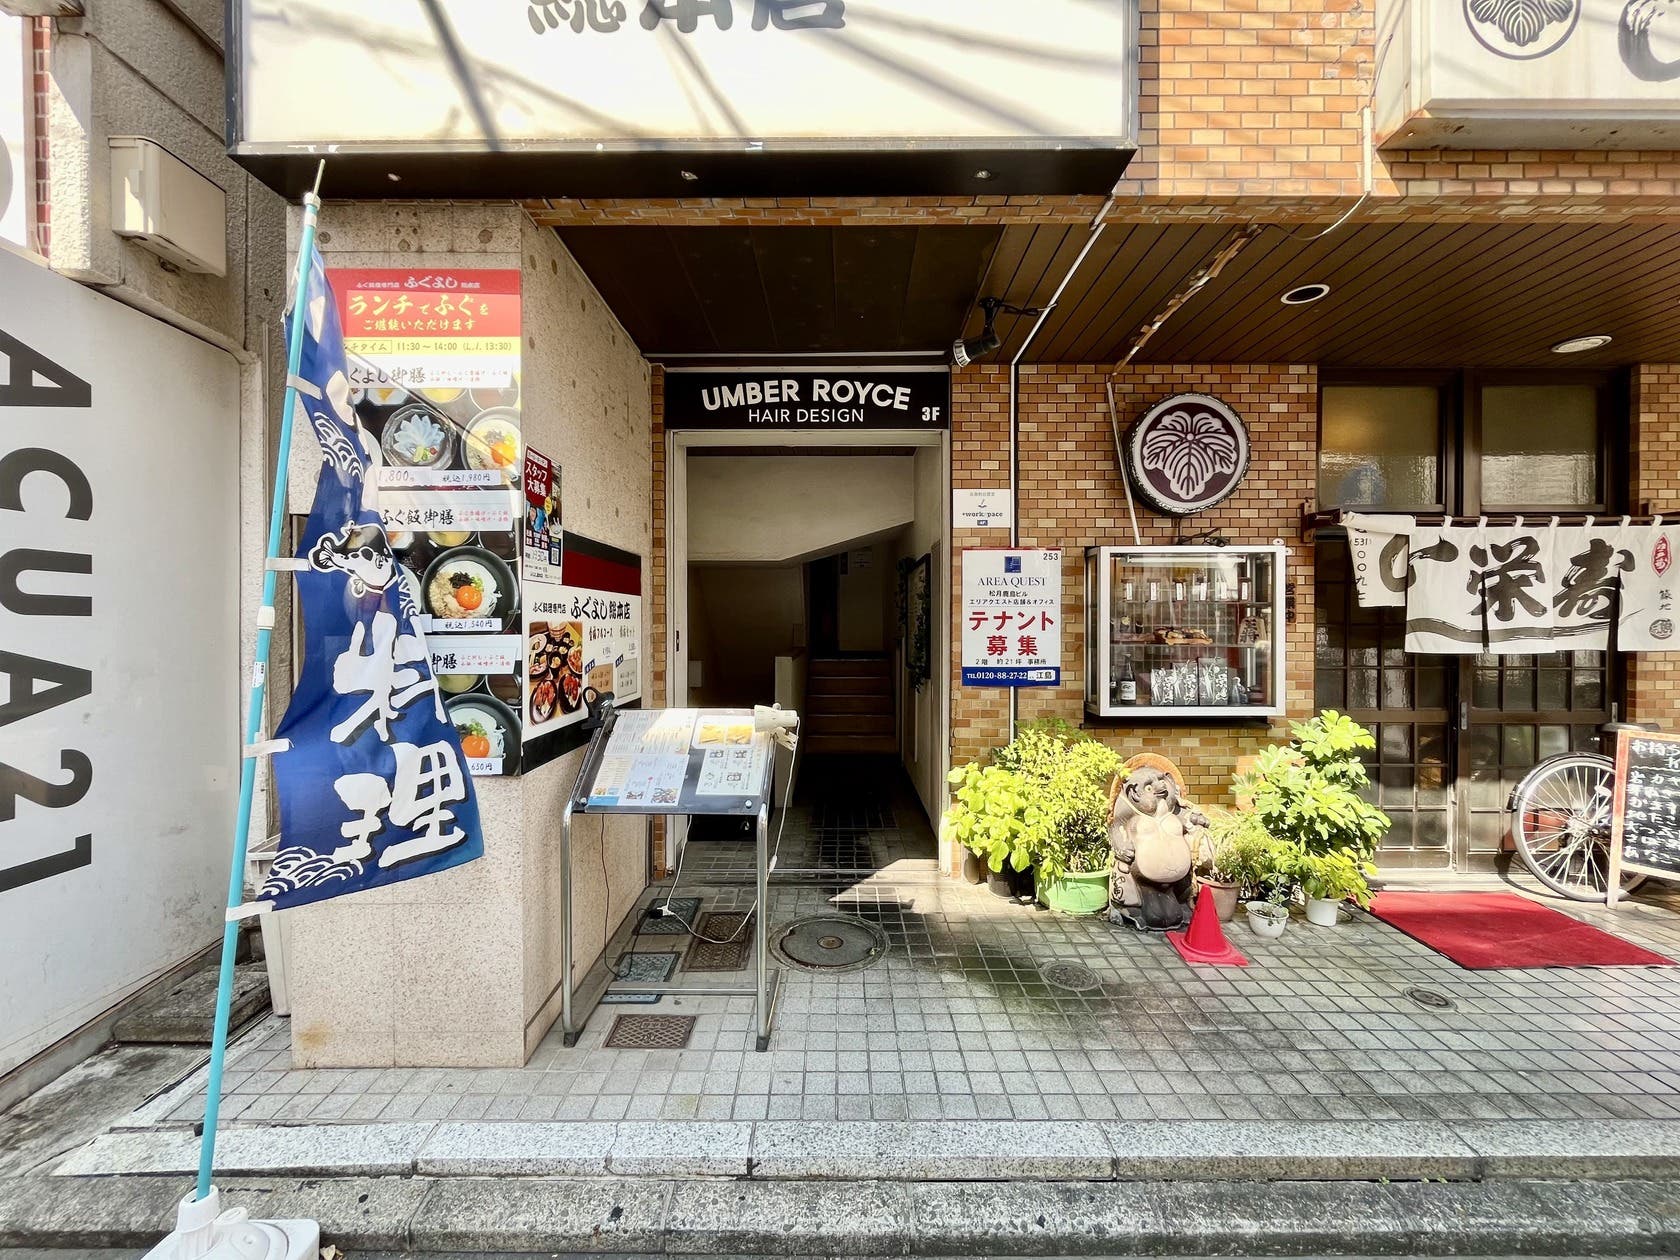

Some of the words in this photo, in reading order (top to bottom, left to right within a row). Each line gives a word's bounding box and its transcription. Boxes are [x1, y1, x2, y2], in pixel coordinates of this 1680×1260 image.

[404, 276, 457, 288] ふぐよし
[363, 319, 476, 331] ご堪能いただけます
[701, 379, 800, 410] UMBER
[812, 378, 912, 411] ROYCE
[748, 409, 790, 423] HAIR
[796, 408, 864, 423] DESIGN
[921, 406, 940, 421] 3F
[1043, 552, 1059, 561] 253
[977, 576, 1008, 587] AREA
[1010, 576, 1047, 588] QUEST
[570, 595, 608, 620] ふぐよし
[968, 611, 1054, 631] テナント
[986, 635, 1038, 656] 募集
[330, 610, 467, 869] 料理
